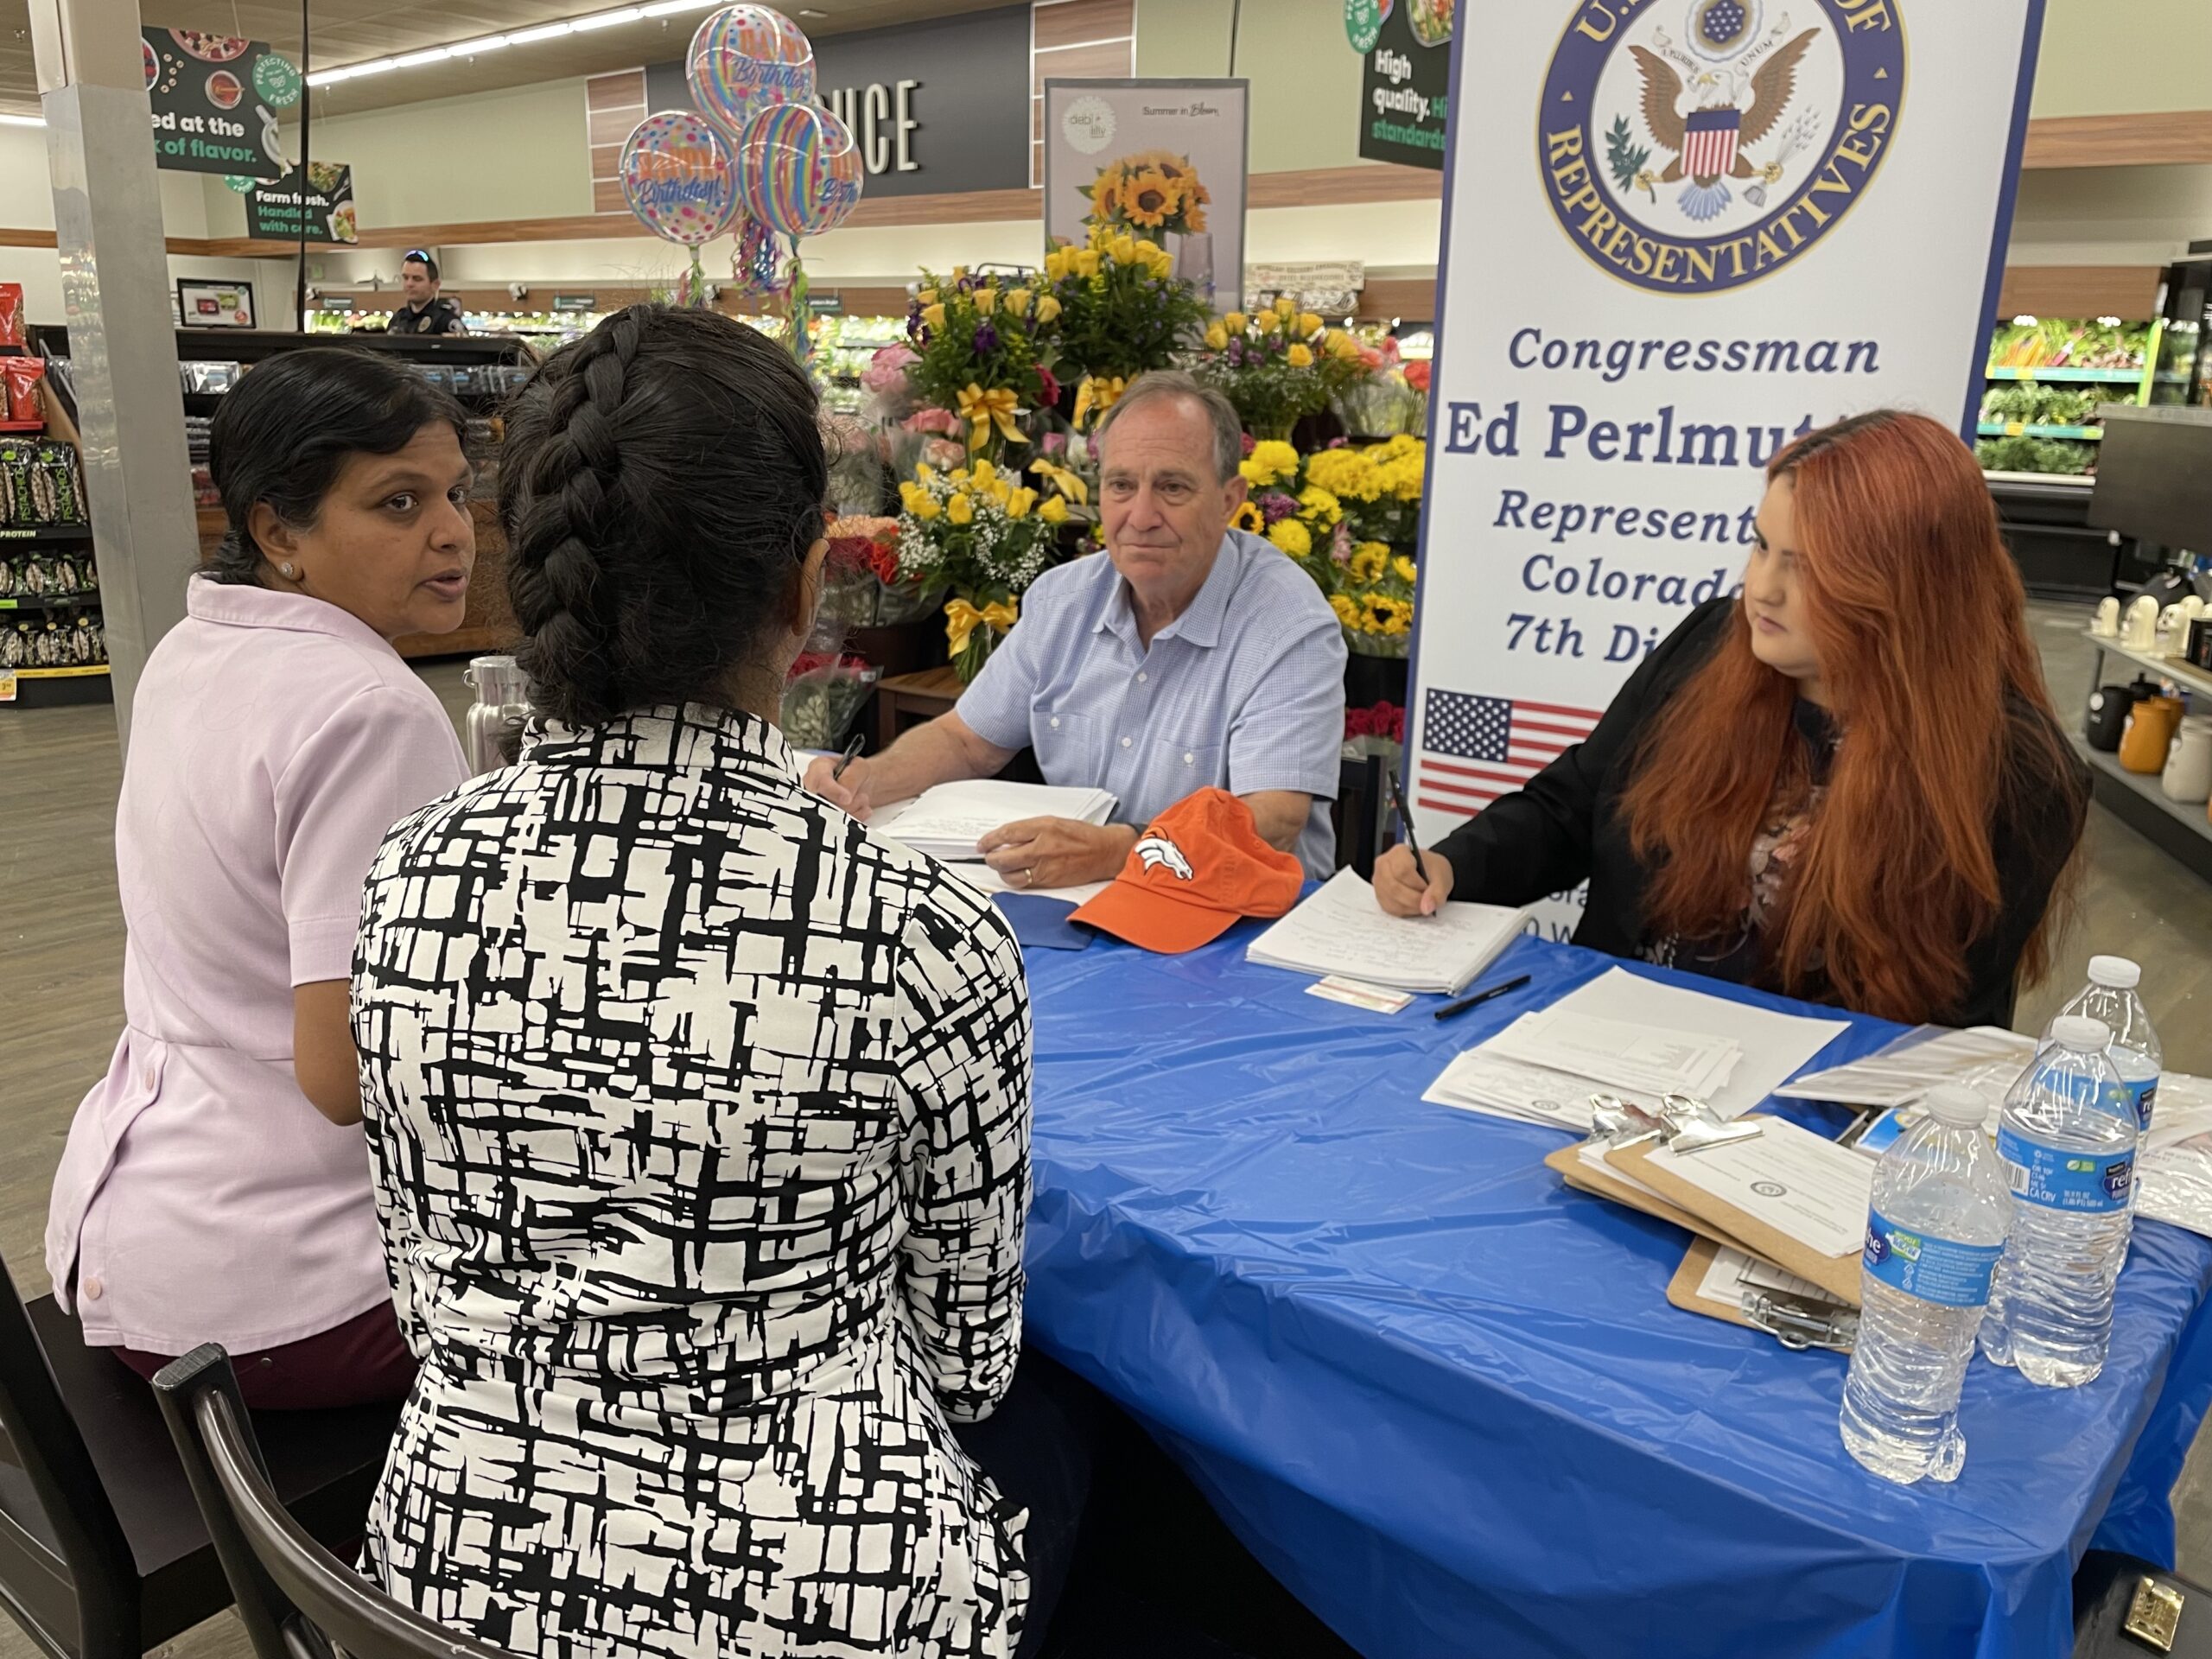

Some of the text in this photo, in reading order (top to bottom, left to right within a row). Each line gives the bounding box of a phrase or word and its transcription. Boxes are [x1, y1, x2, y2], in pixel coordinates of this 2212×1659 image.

[1573, 0, 1891, 41] U. F
[1374, 48, 1413, 85] High
[1142, 105, 1179, 116] Summer
[1180, 106, 1189, 116] in
[1372, 86, 1431, 123] quality.
[180, 115, 205, 133] at
[208, 117, 245, 138] the
[815, 79, 918, 175] UCE
[164, 137, 187, 156] of
[190, 138, 257, 162] flavor.
[256, 190, 290, 205] Farm
[1548, 102, 1891, 284] REPRESENTATIVES
[259, 220, 289, 232] with
[1508, 327, 1880, 383] Congressman
[1444, 401, 1847, 468] Ed Perlmu
[1494, 489, 1757, 545] Represent
[1506, 613, 1585, 658] 7th
[2030, 1187, 2056, 1203] CA CRV
